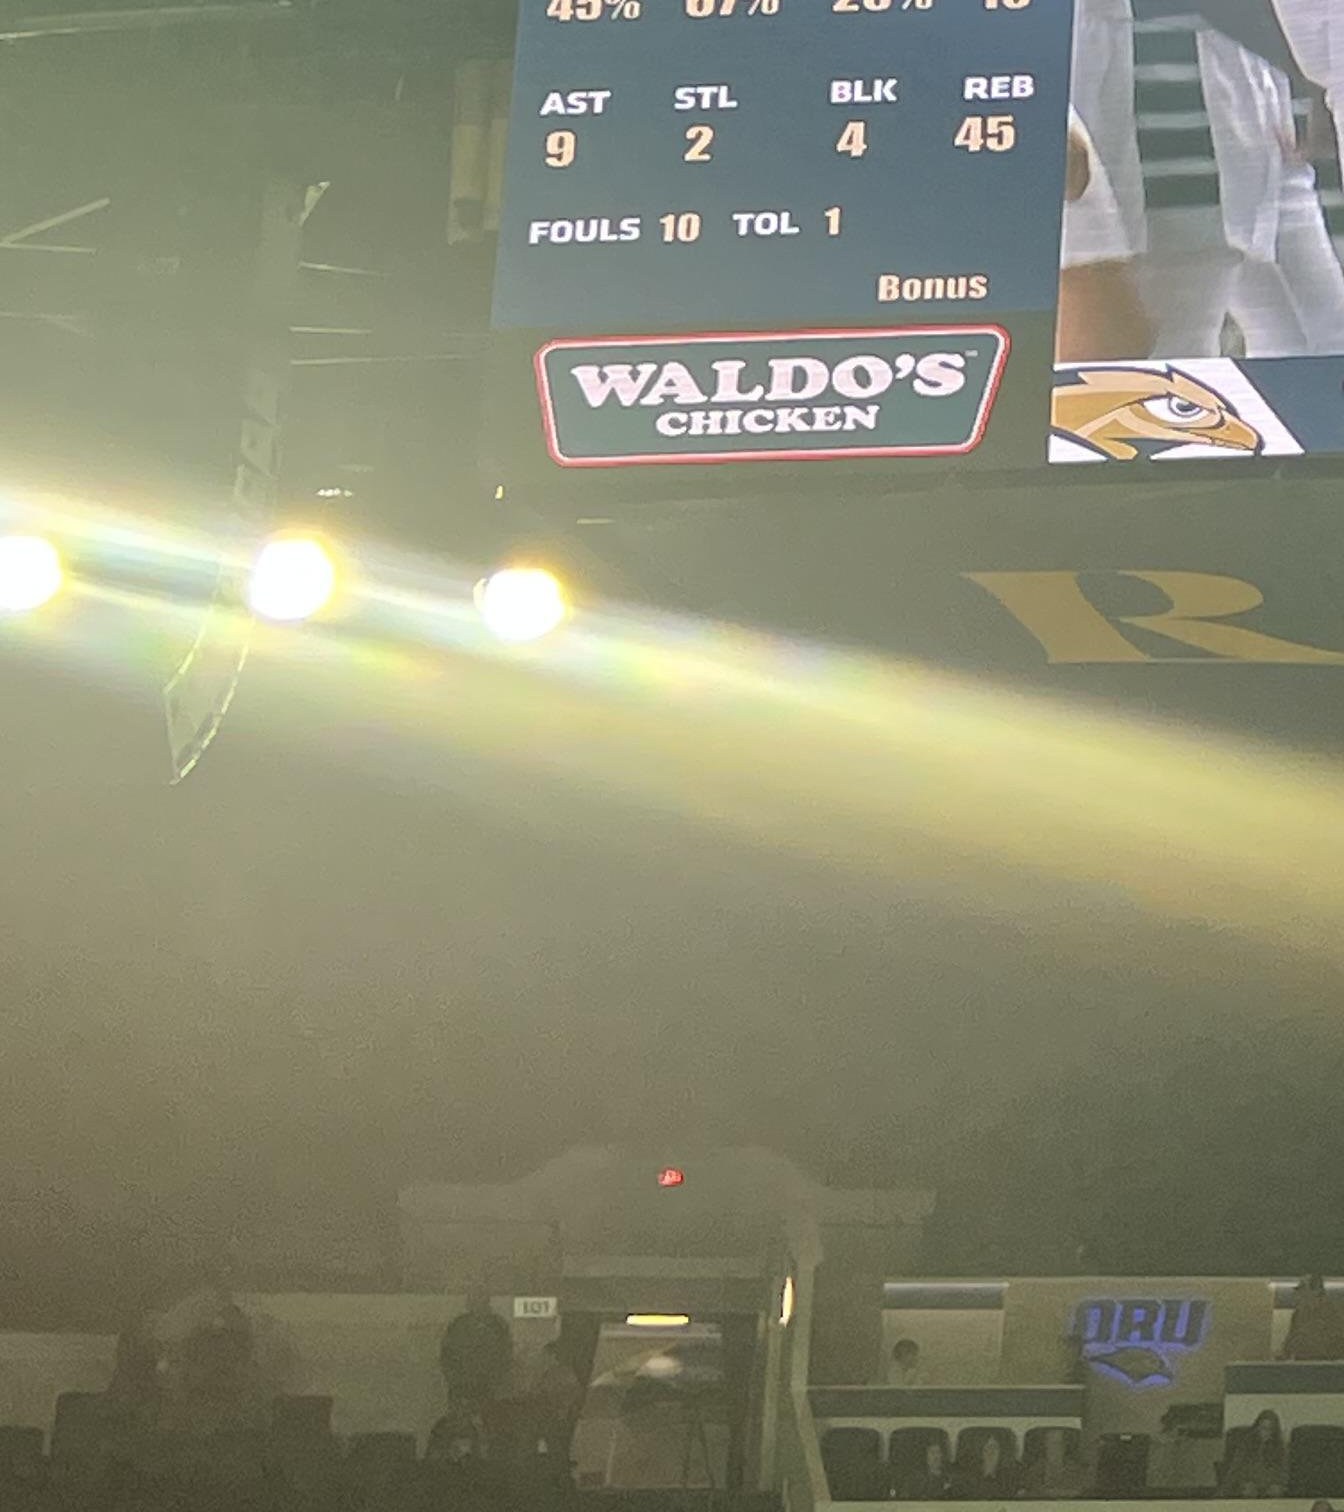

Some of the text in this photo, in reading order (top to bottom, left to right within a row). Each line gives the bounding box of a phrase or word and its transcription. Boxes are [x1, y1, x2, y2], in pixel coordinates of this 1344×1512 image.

[540, 76, 1034, 114] AST STL BLK REB
[546, 115, 1015, 167] 9 2 4 45
[529, 207, 842, 244] FOULS 10 TOL 1
[878, 274, 987, 301] Bonus
[656, 405, 879, 437] CHICKEN
[1075, 1299, 1207, 1344] ORU
